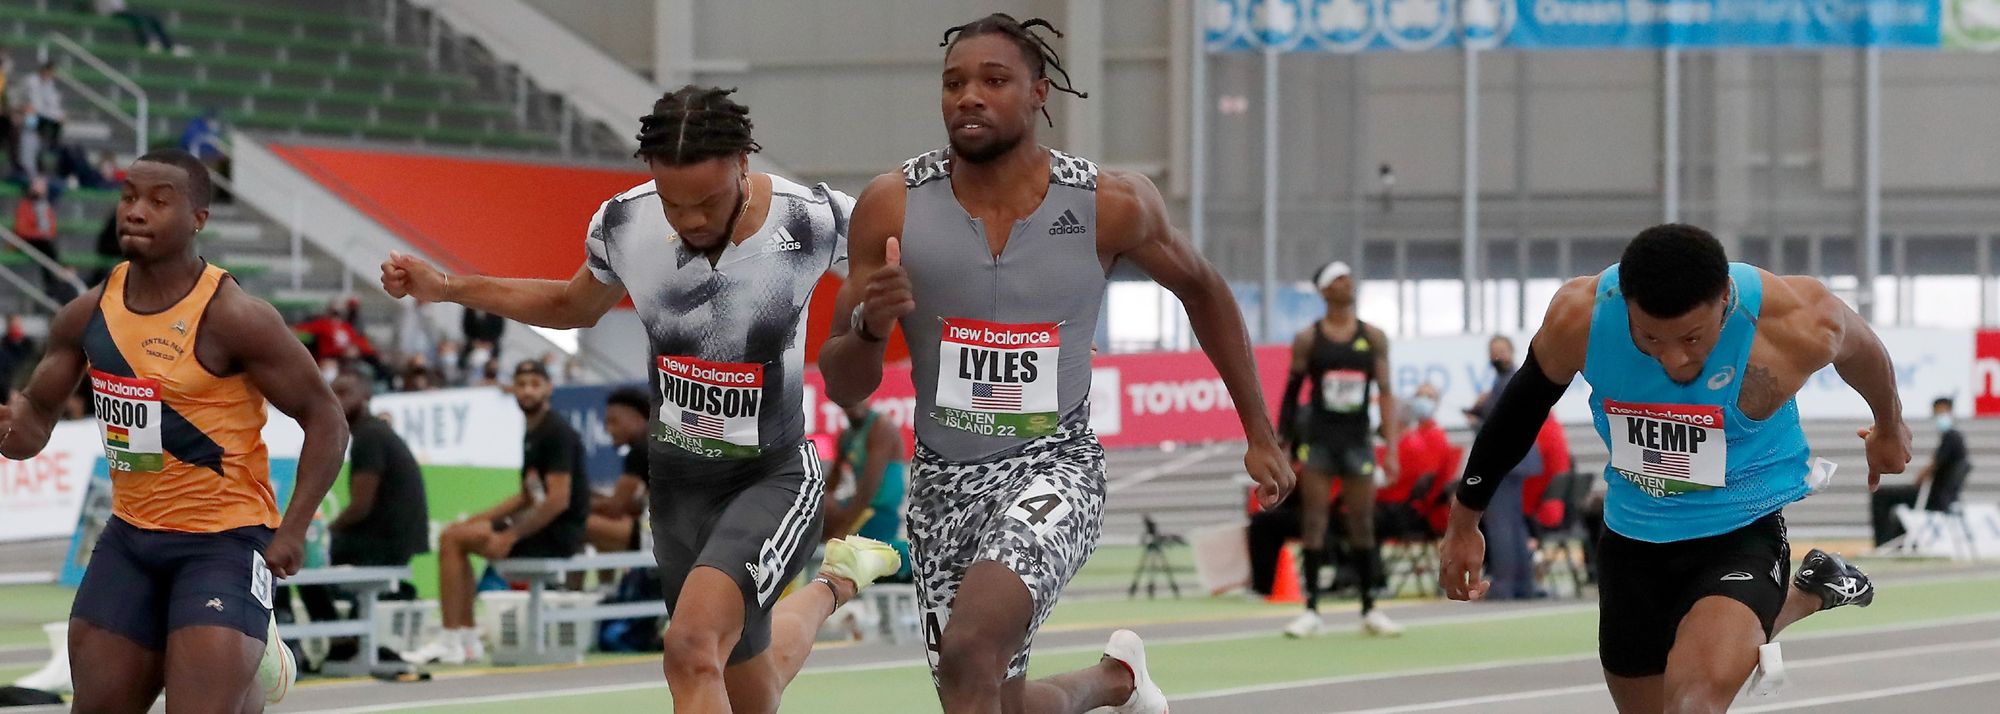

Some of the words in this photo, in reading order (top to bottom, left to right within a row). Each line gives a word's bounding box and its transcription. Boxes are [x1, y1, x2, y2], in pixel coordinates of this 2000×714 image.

[1049, 225, 1086, 235] adidas
[141, 337, 169, 348] CENTRAL
[949, 325, 981, 341] new
[984, 328, 1050, 345] balance
[663, 357, 689, 374] new
[691, 364, 755, 383] balance
[959, 347, 1038, 383] LYLES
[107, 380, 154, 398] balance
[663, 373, 758, 419] HUDSON
[1128, 378, 1236, 415] TOYOT
[95, 395, 148, 429] SOSOO
[945, 408, 995, 425] STATEN
[1645, 409, 1714, 425] balance
[945, 417, 994, 435] ISLAND
[997, 426, 1016, 436] 22
[1626, 417, 1707, 453] KEMP
[665, 426, 702, 448] STATEN
[118, 461, 131, 471] 22
[1619, 470, 1666, 489] STATEN
[1017, 493, 1063, 526] 4
